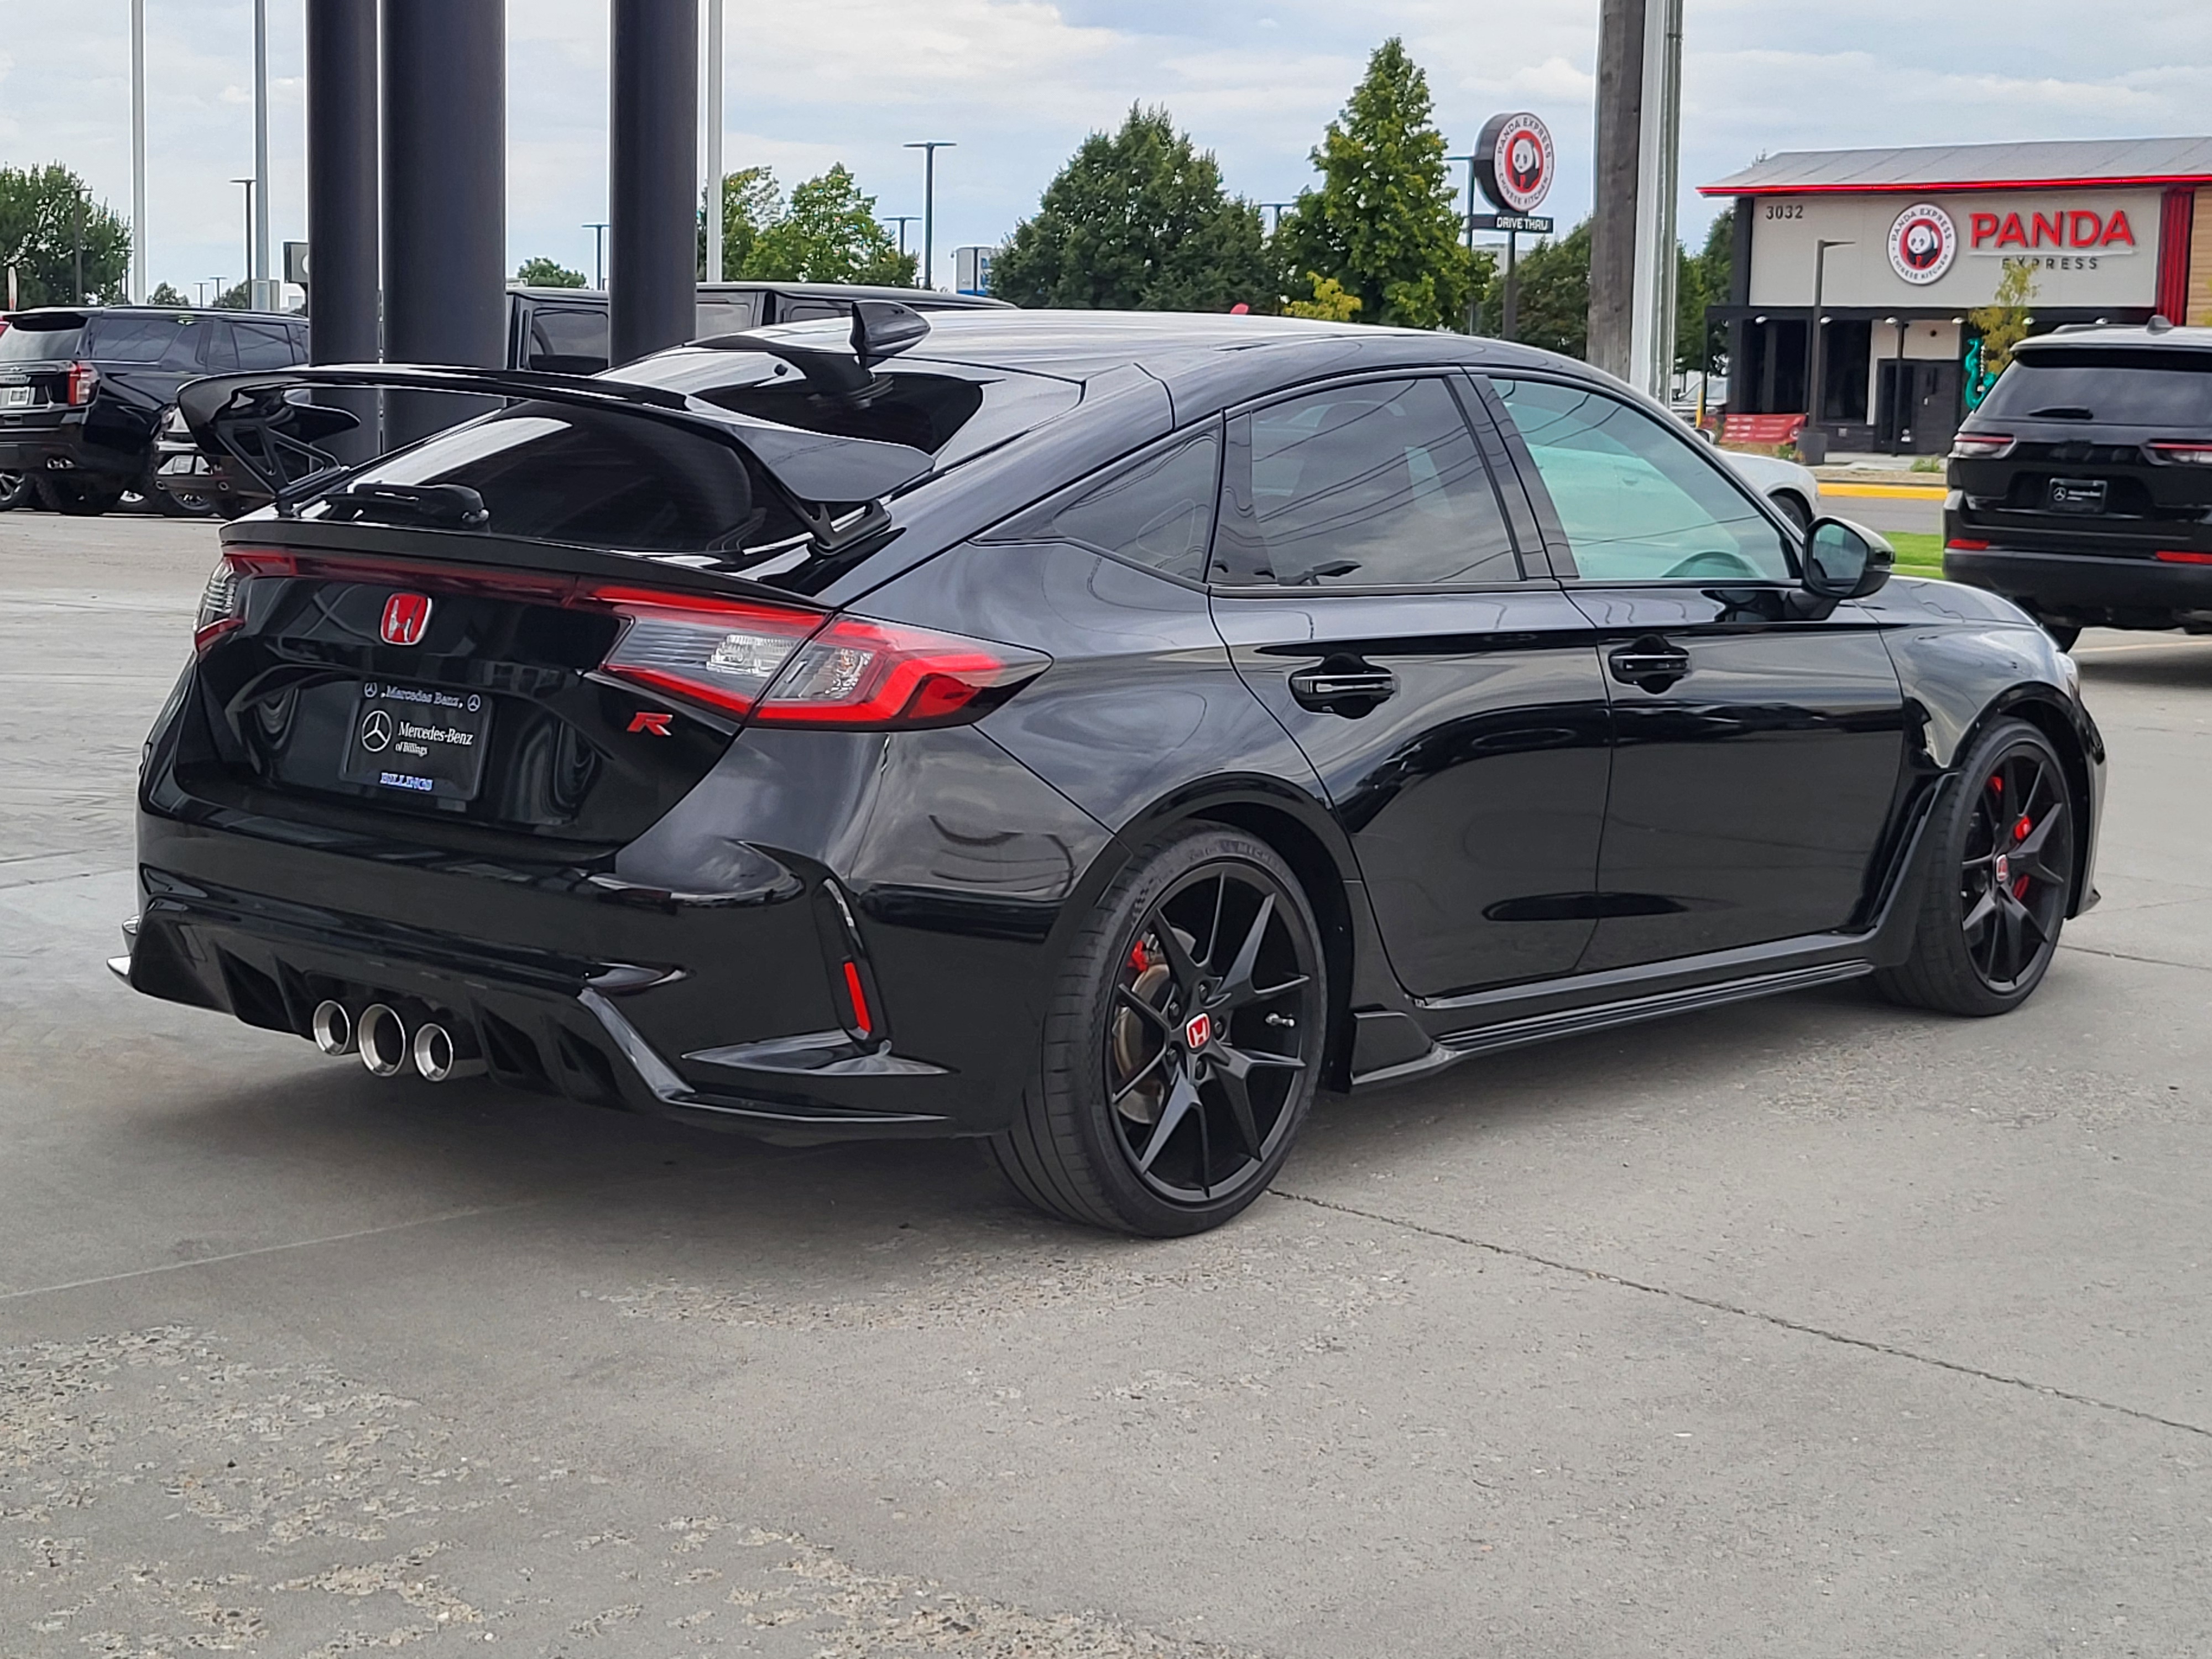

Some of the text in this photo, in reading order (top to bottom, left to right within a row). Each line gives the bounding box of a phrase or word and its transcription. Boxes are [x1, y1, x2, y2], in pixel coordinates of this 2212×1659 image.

[1498, 117, 1552, 159] PANDA EXPRESS
[1496, 216, 1549, 231] DRIVE THRU
[1766, 205, 1803, 220] 3032
[1892, 208, 1952, 242] PANDA EXPRESS
[1969, 210, 2135, 249] PANDA
[2001, 257, 2099, 270] EXPRESS
[398, 721, 474, 745] Mercedes-Benz
[627, 712, 674, 736] R
[395, 742, 428, 757] of Billings
